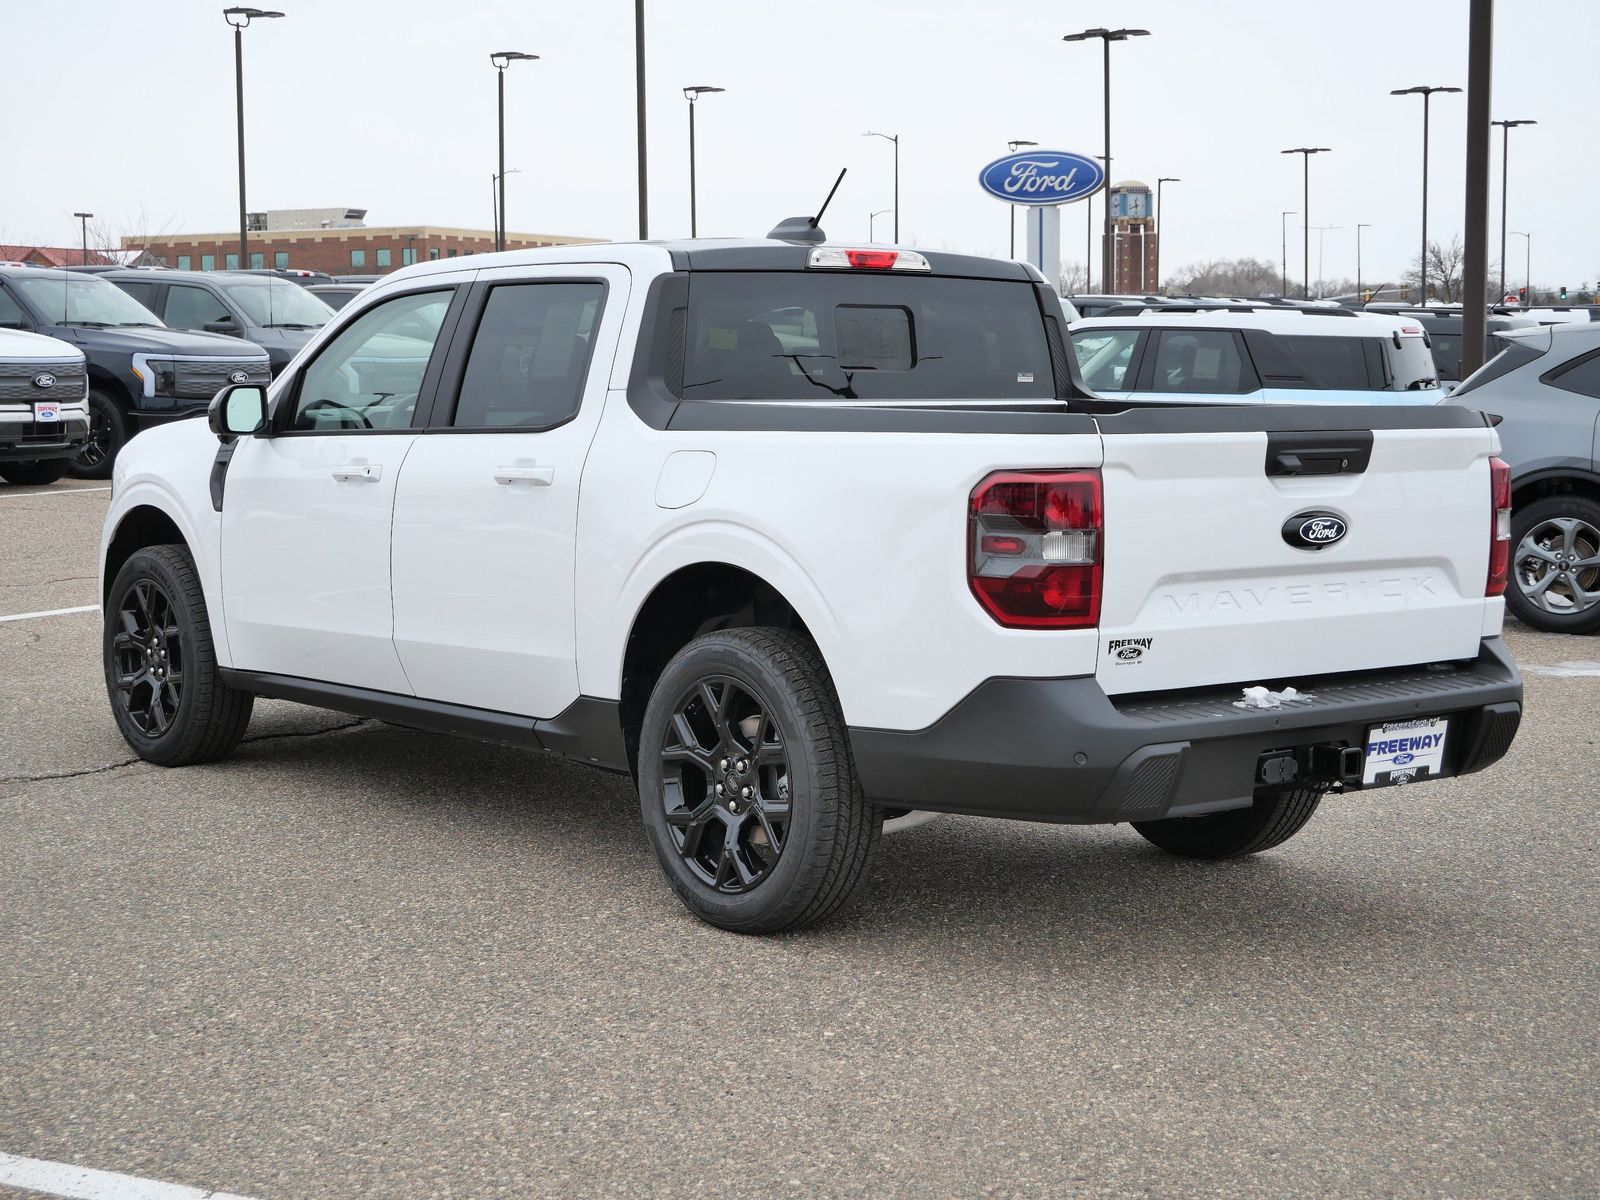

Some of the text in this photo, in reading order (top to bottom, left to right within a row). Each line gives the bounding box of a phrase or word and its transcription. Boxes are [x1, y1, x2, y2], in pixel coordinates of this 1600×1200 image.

[1003, 160, 1078, 193] Ford
[1308, 521, 1337, 539] Ford
[1163, 576, 1436, 613] MAVERICK
[1108, 637, 1153, 655] FREEWAY
[1121, 649, 1139, 659] Ford
[1366, 733, 1444, 756] FREEWAY
[1395, 754, 1411, 764] Ford
